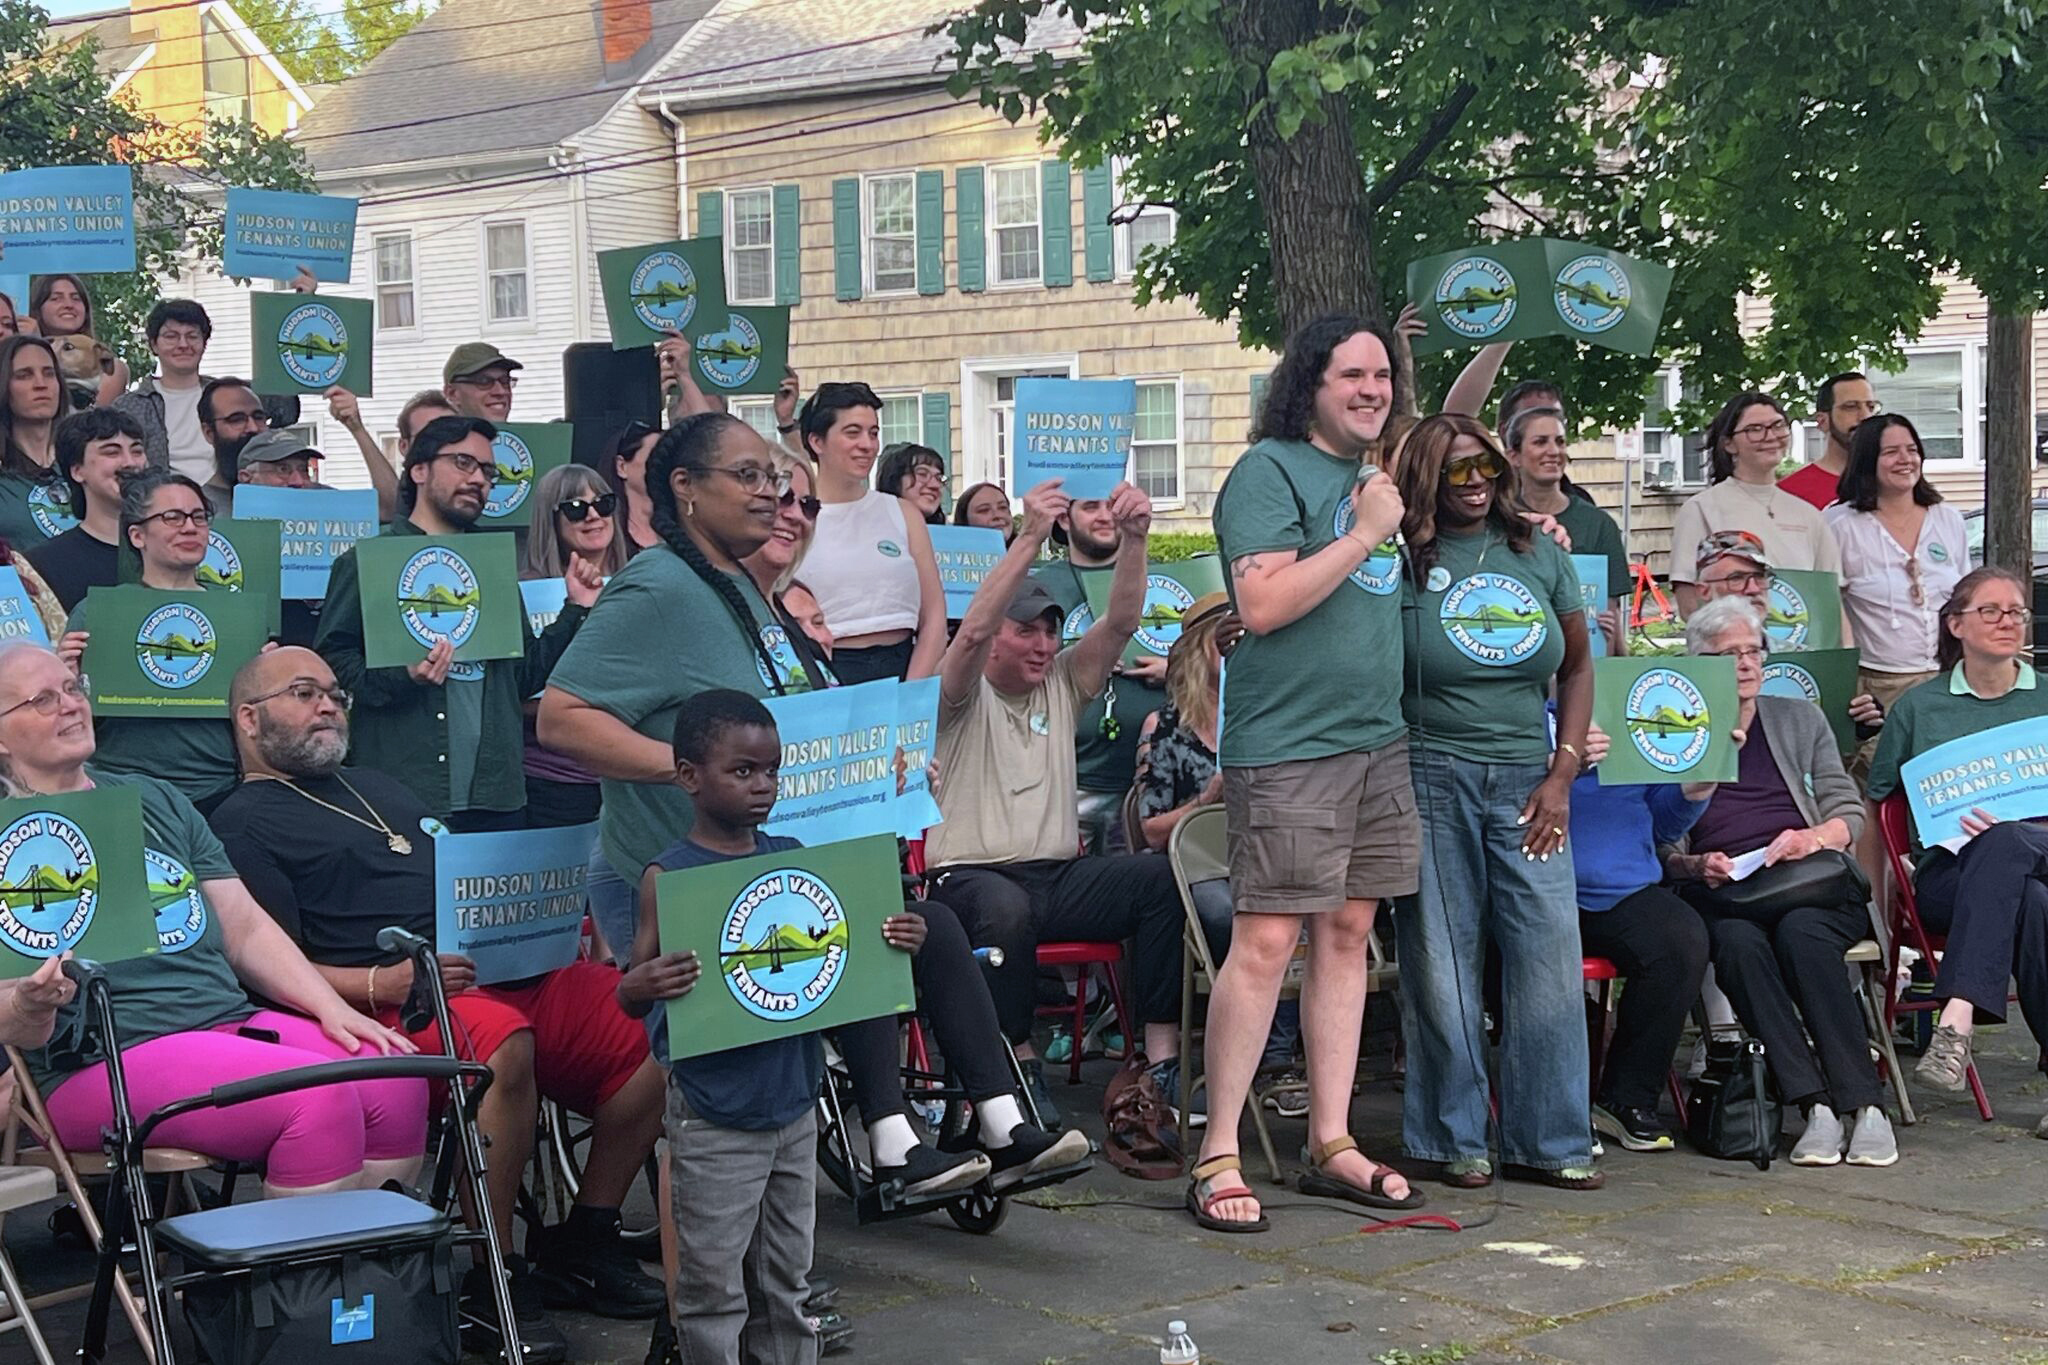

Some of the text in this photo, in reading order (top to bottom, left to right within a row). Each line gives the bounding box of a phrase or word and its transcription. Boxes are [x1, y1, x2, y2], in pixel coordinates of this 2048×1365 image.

[0, 195, 124, 214] UDSON VALLEY
[0, 215, 125, 234] ENANTS UNION
[235, 213, 349, 235] HUDSON VALLEY
[236, 230, 346, 250] TENANTS UNION
[634, 256, 664, 290] HUDSON
[1439, 260, 1512, 297] HUDSON VALLEY
[1563, 259, 1602, 280] HUDSON
[282, 307, 346, 340] HUDSON VALLEY
[1444, 297, 1513, 334] TENANTS UNION
[1557, 290, 1587, 327] TENANTS
[281, 349, 320, 382] TENANTS
[1026, 412, 1102, 432] HUDSON
[504, 435, 530, 468] VALLEY
[1026, 434, 1109, 454] TENANTS
[280, 519, 372, 537] SON VALLEY
[280, 540, 324, 557] ANTS
[954, 551, 1000, 568] VALLEY
[402, 551, 475, 593] HUDSON VALLEY
[1492, 576, 1539, 614] VALLEY
[143, 607, 212, 639] HUDSON VALLEY
[451, 604, 476, 640] UNION
[1451, 620, 1544, 661] TENANTS UNION
[142, 650, 211, 684] TENANTS UNION
[1785, 667, 1817, 700] VALLEY
[1630, 672, 1703, 713] HUDSON VALLEY
[780, 724, 888, 769] UDSON VALLEY
[1634, 725, 1706, 766] TENANTS UNION
[776, 768, 837, 801] ENANTS
[840, 756, 887, 788] UNION
[1917, 743, 2048, 794] HUDSON VALL
[1922, 770, 2013, 809] TENANTS
[768, 791, 887, 825] udsonvalleytenantsunion.org
[46, 817, 91, 866] VALLEY
[453, 872, 533, 901] HUDSON
[61, 887, 93, 940] UNION
[185, 887, 202, 932] UNION
[455, 891, 583, 931] TENANTS UNION
[727, 874, 840, 943] HUDSON VALLEY
[731, 943, 842, 1011] TENANTS UNION
